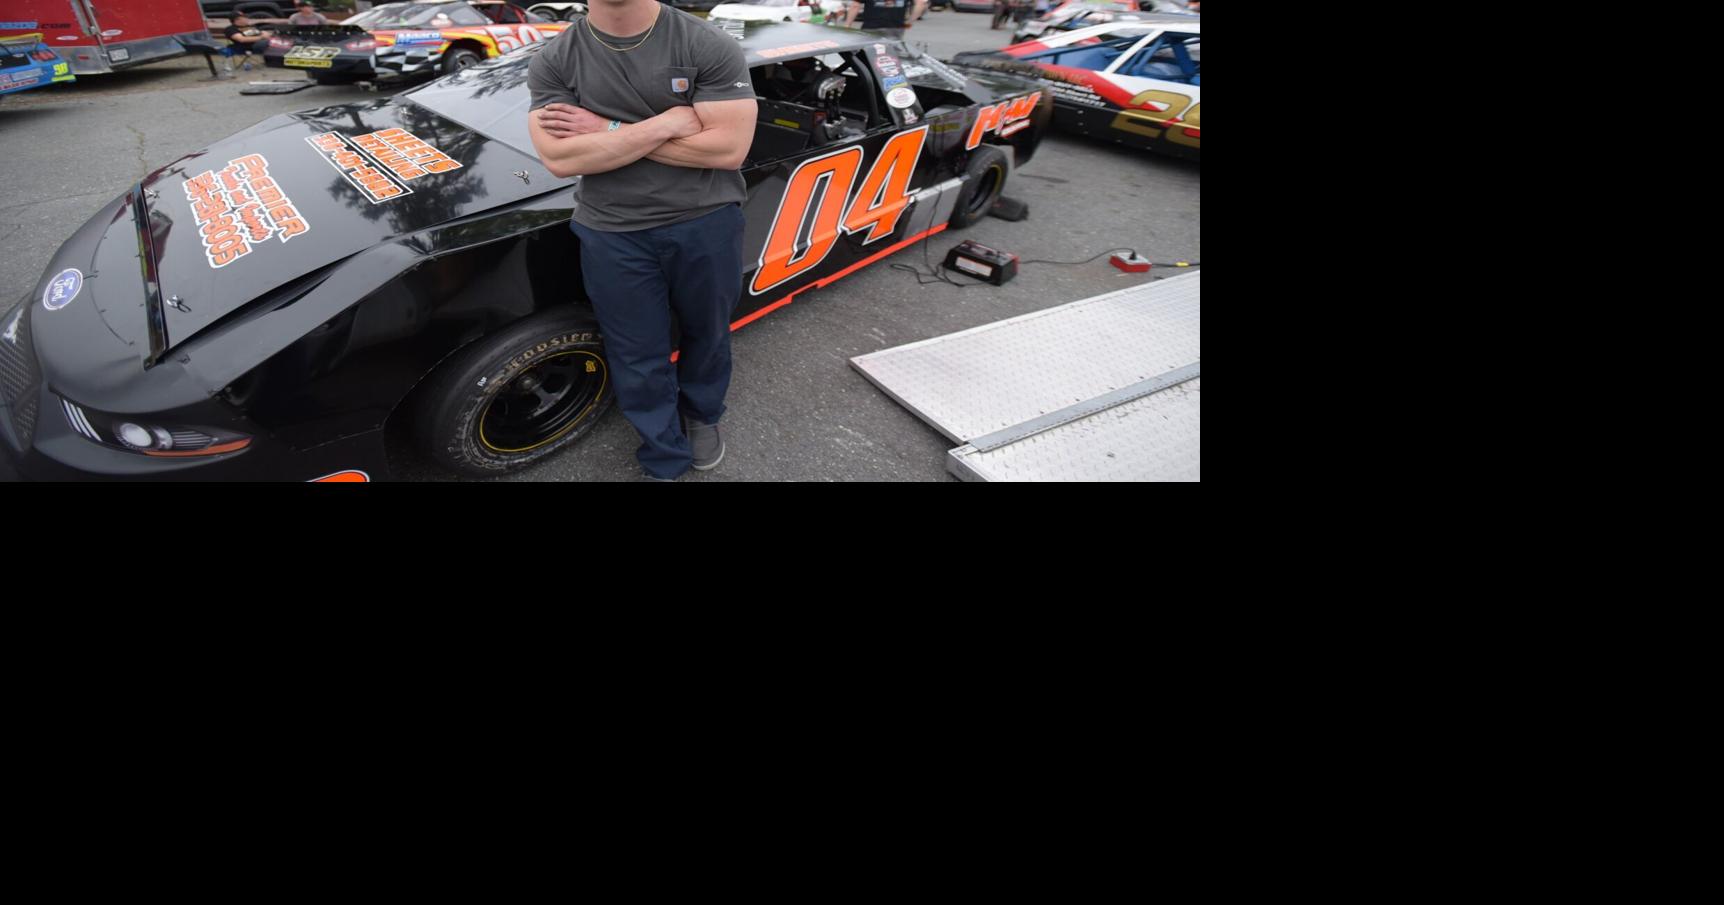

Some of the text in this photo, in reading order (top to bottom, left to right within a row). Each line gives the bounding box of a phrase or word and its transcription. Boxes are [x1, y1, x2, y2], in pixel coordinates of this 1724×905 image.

[485, 25, 545, 54] 50
[229, 154, 309, 242] PREMIER
[749, 125, 929, 296] 04
